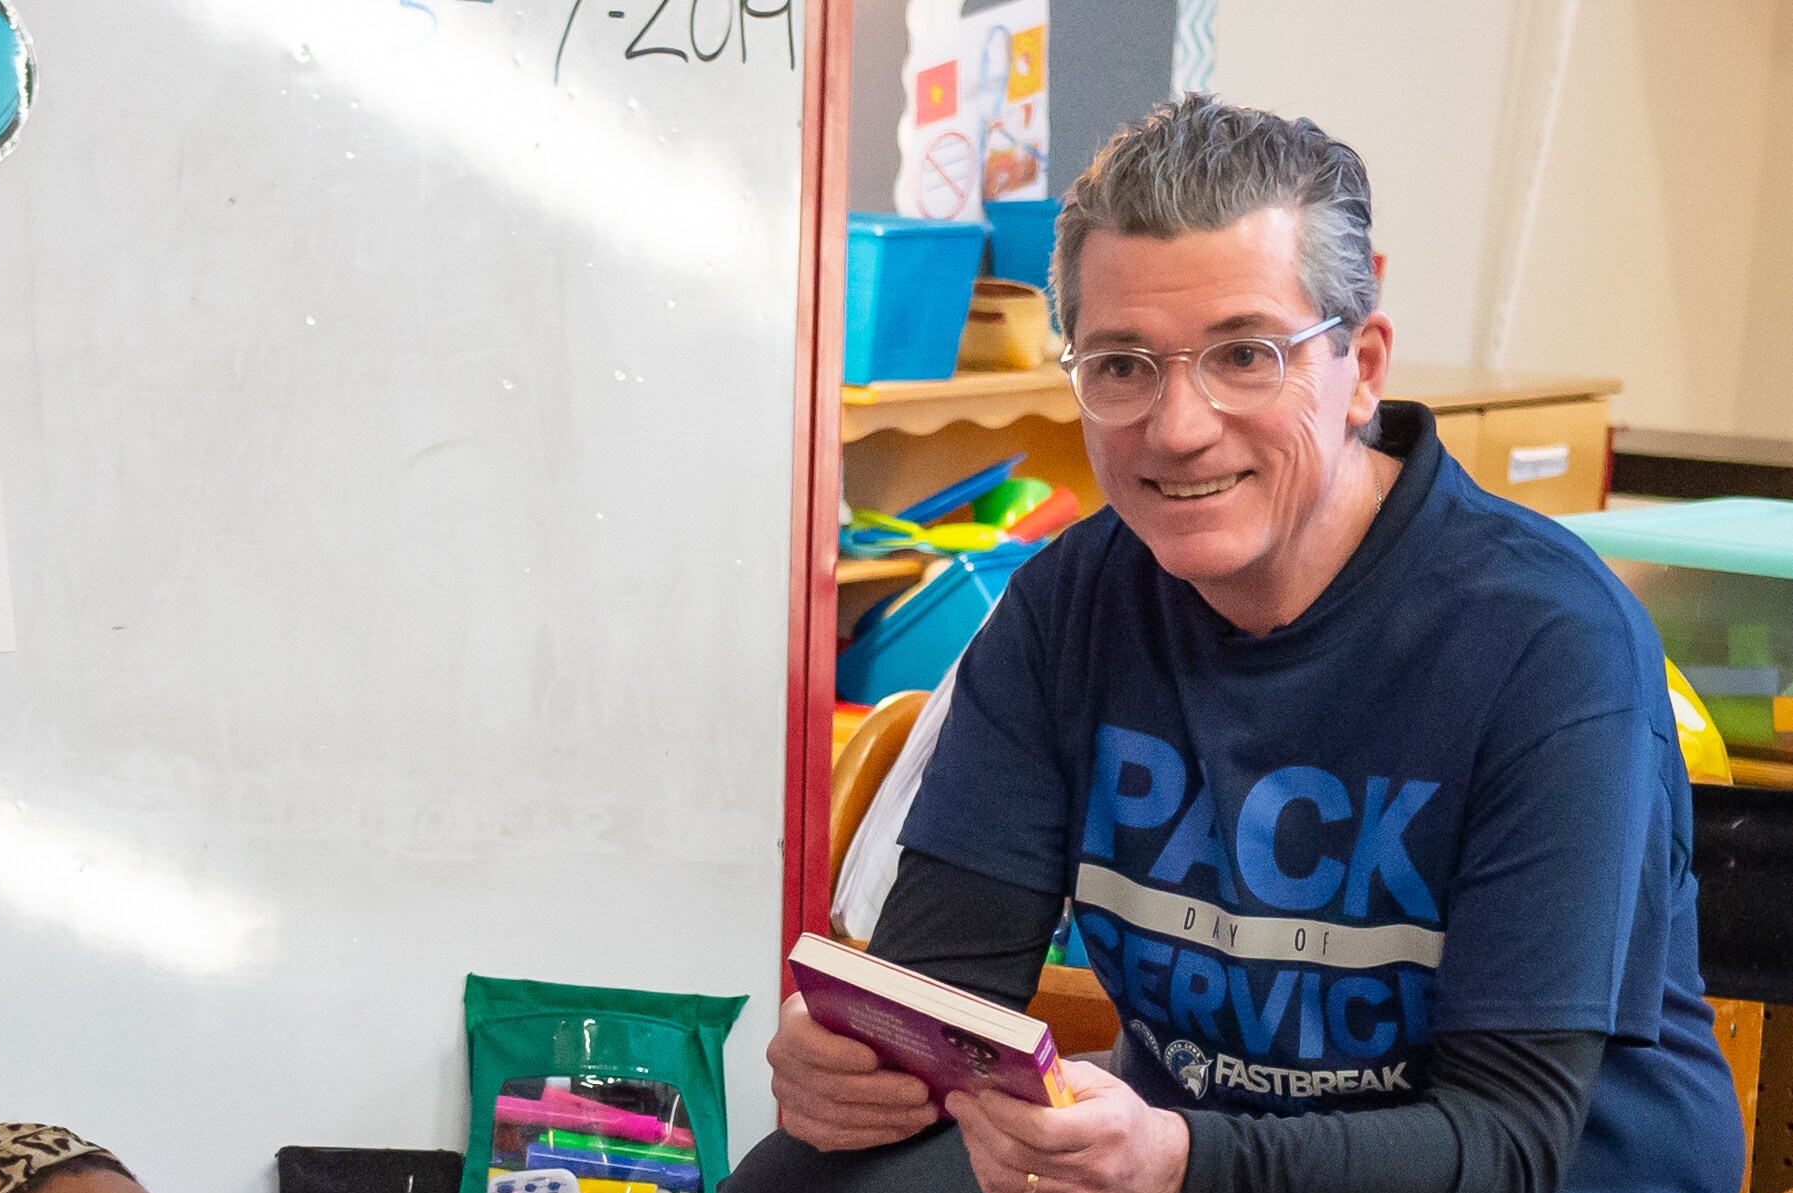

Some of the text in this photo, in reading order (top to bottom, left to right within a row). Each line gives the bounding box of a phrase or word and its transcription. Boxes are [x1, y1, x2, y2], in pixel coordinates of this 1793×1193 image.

[1083, 723, 1441, 921] PACK
[1184, 906, 1332, 956] DAY OF
[1214, 1052, 1412, 1099] FASTBREAK
